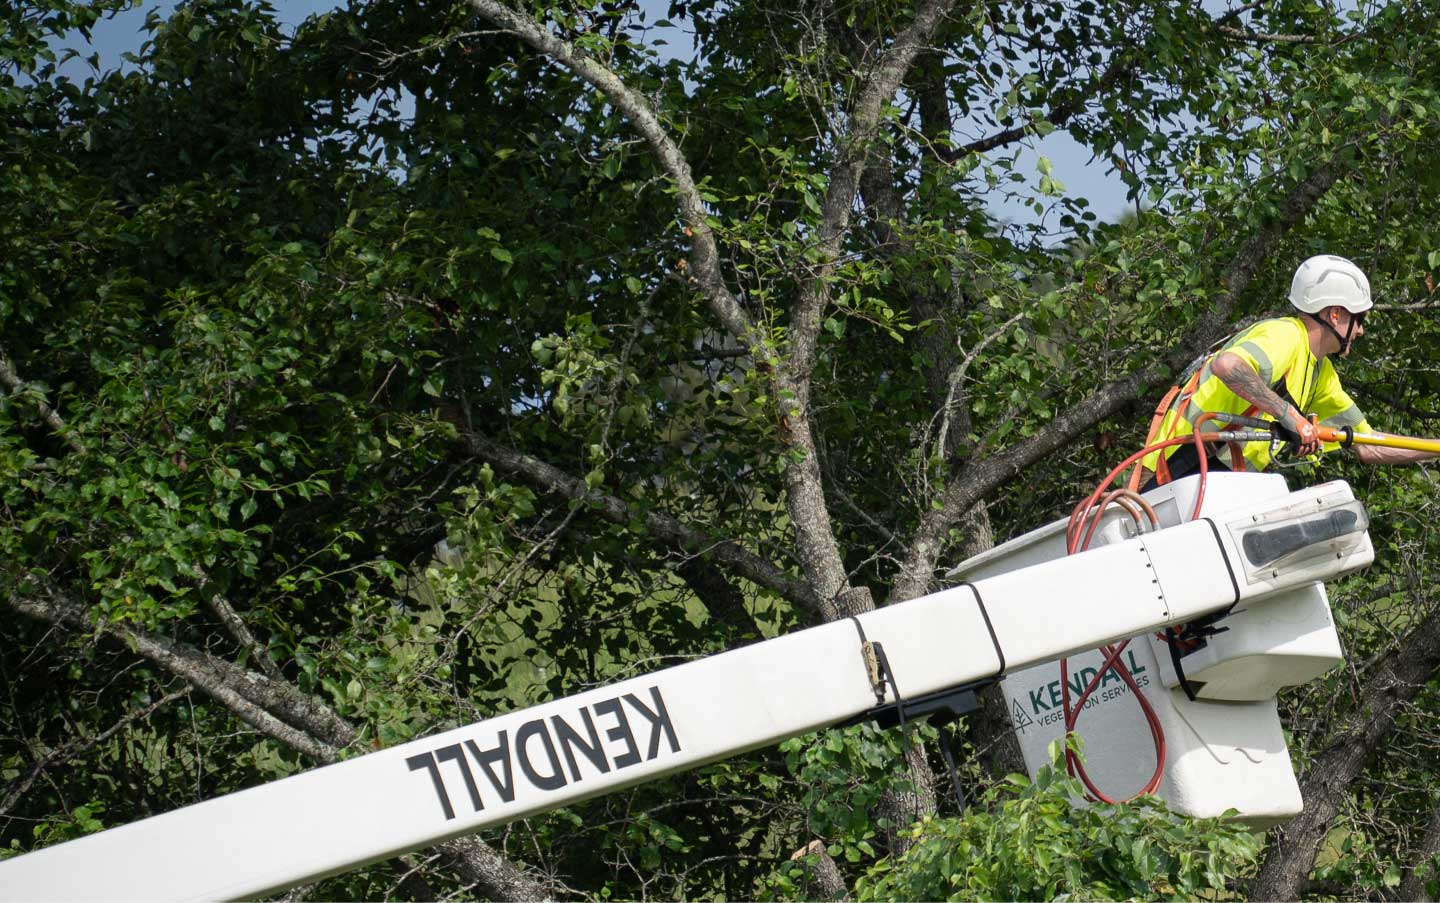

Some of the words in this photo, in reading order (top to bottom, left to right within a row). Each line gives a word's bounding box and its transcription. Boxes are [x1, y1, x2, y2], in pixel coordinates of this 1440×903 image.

[1028, 650, 1146, 714] KENDAL
[1036, 696, 1100, 727] VEGEON
[1103, 677, 1150, 702] SERVIES
[405, 685, 681, 820] KENDALL
